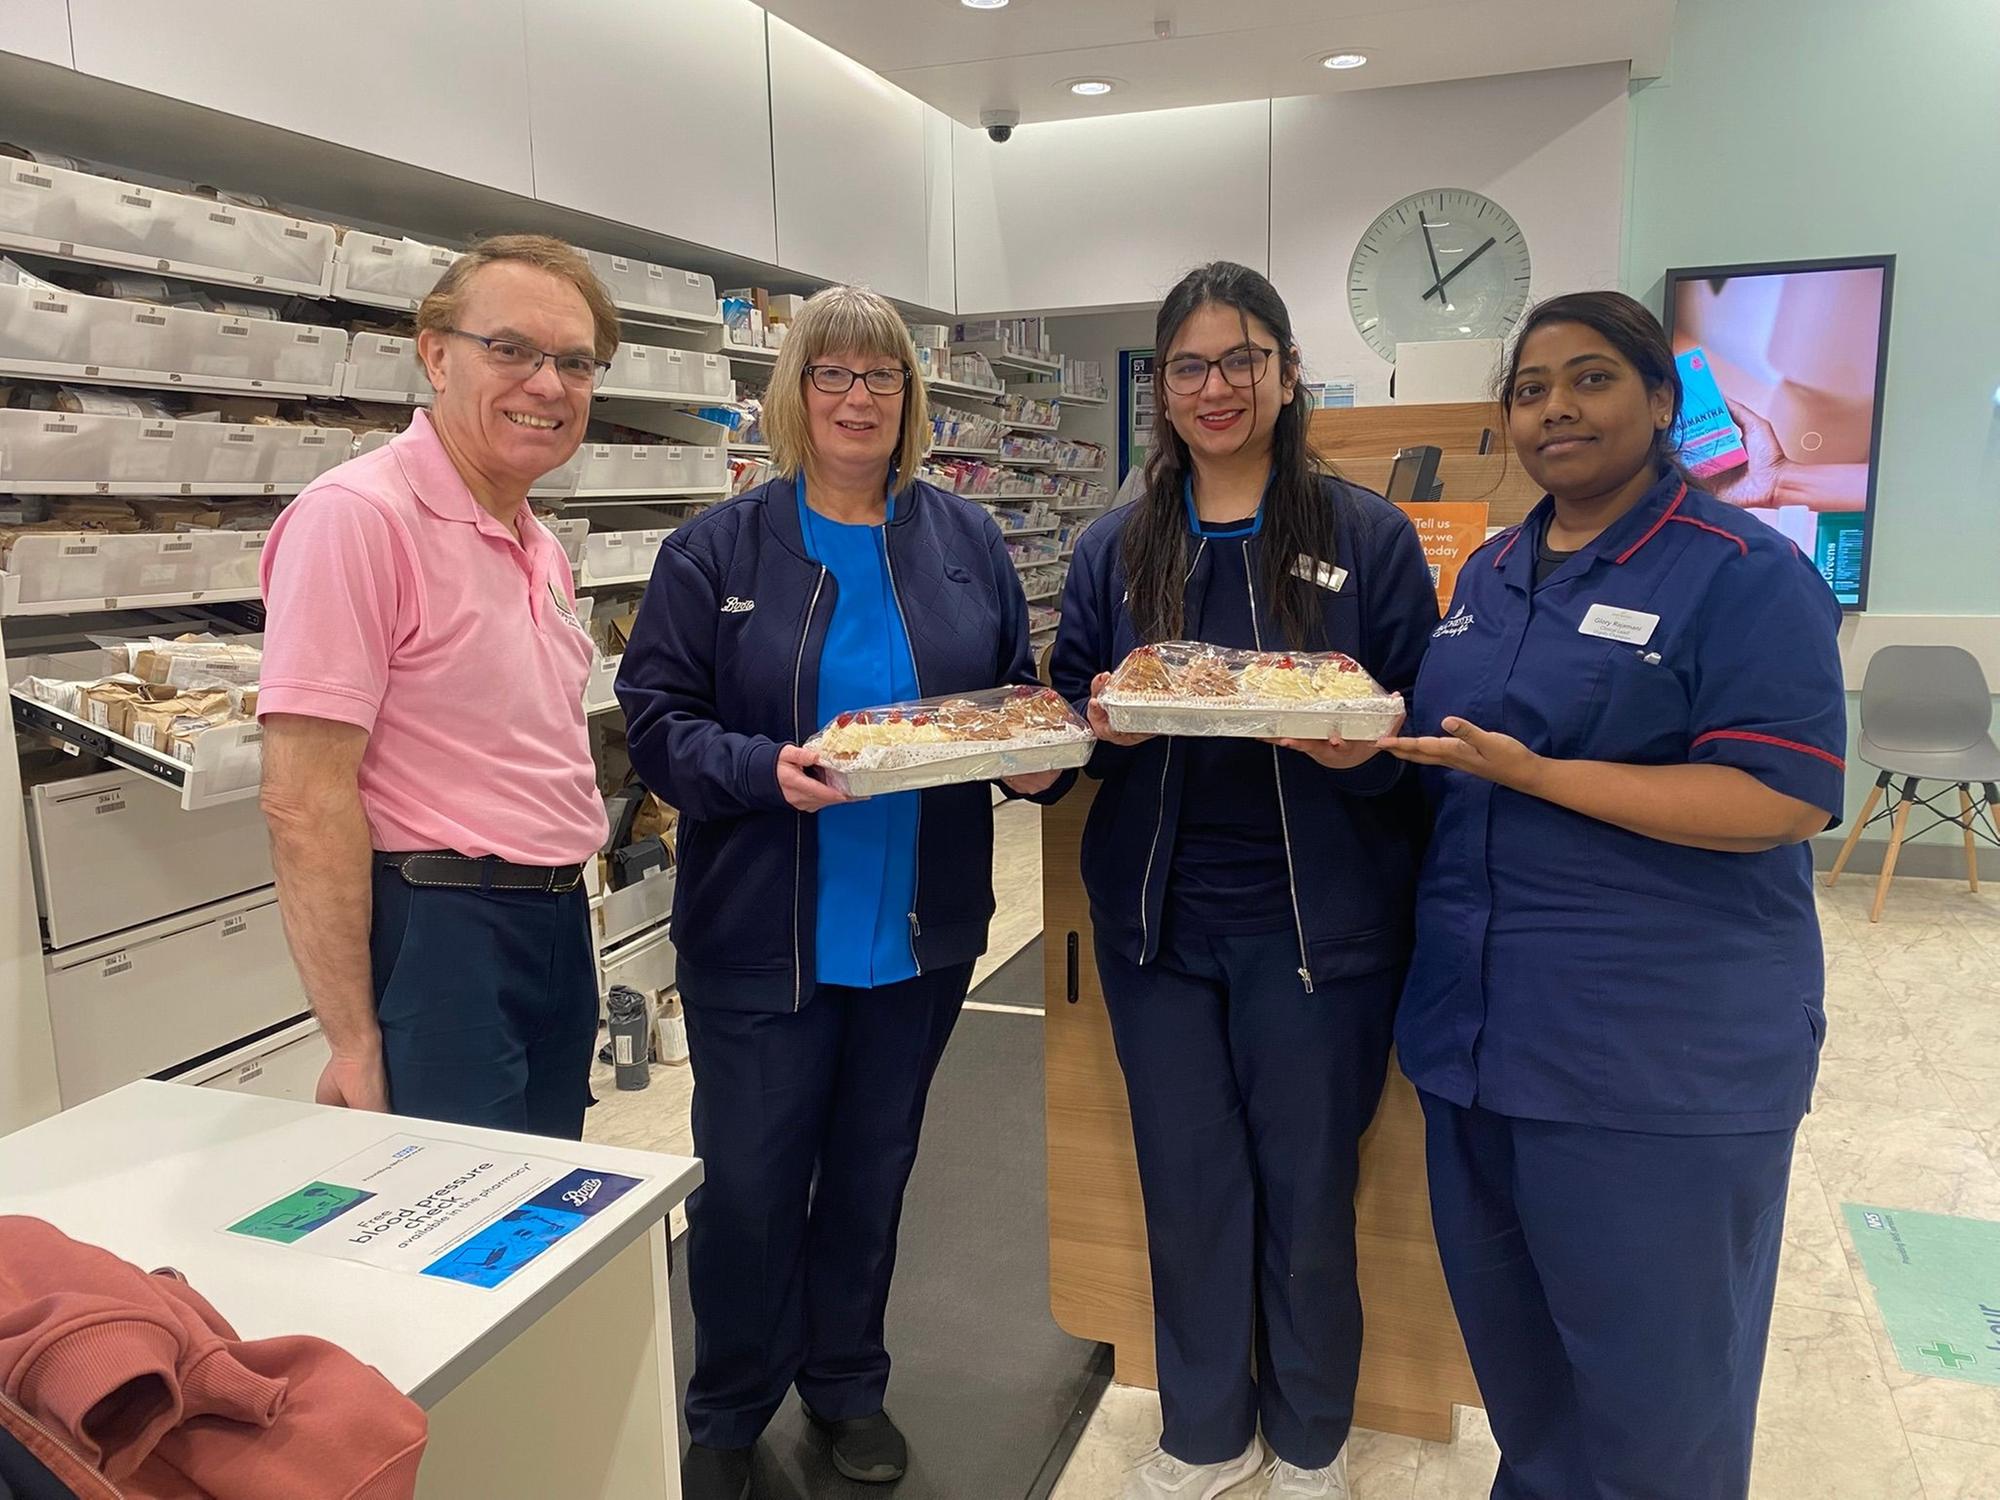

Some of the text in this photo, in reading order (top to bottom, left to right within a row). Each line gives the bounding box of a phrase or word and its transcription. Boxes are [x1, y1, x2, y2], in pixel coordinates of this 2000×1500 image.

[1414, 518, 1434, 529] Tell
[1418, 533, 1454, 542] ow we
[1423, 545, 1460, 559] today
[1824, 542, 1836, 581] Greens
[348, 1208, 417, 1244] blood
[415, 1161, 494, 1209] pressure
[561, 1178, 602, 1207] Boots
[357, 1210, 392, 1229] Free
[398, 1215, 450, 1249] available
[459, 1196, 480, 1209] the
[404, 1196, 463, 1230] check
